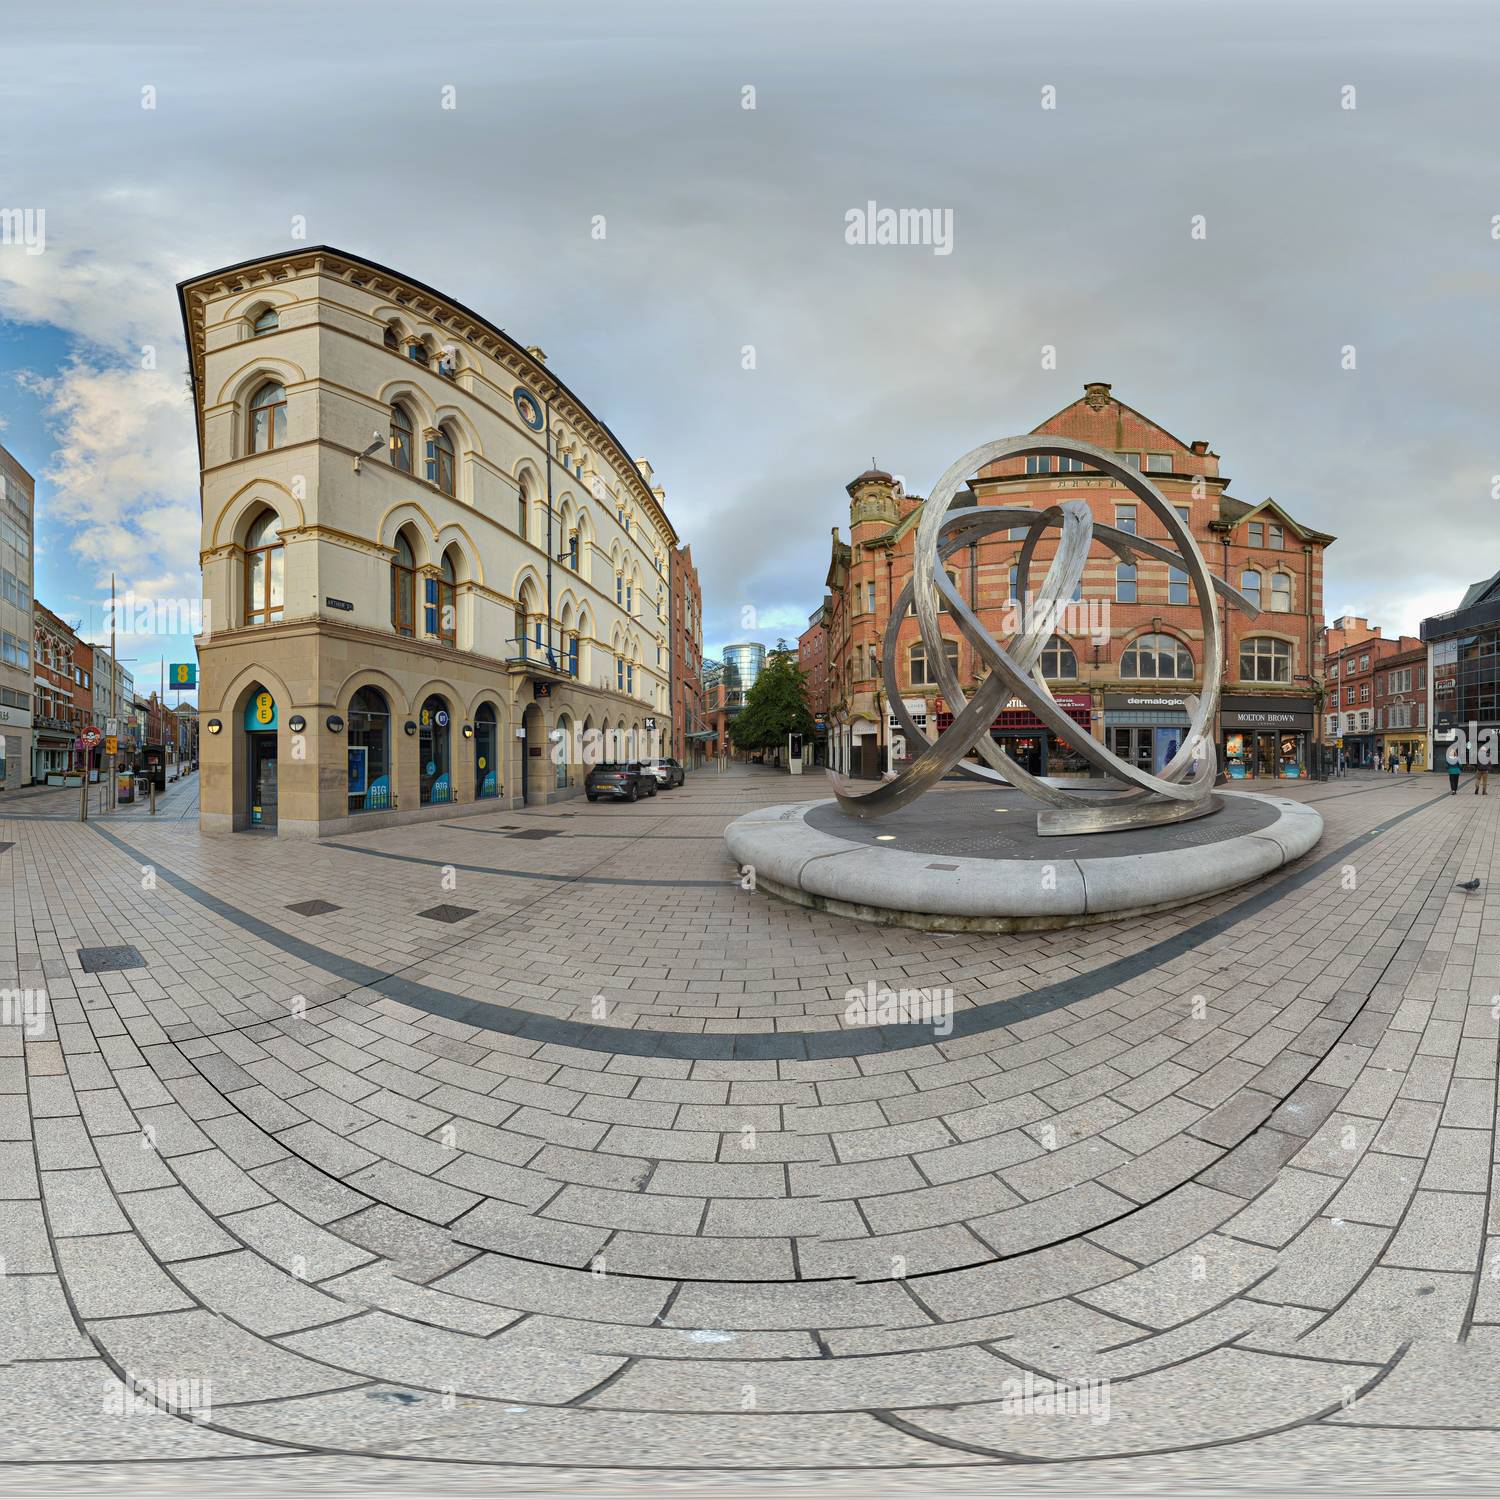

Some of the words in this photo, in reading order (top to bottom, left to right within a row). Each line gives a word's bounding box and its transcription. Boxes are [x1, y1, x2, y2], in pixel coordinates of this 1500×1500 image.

[1237, 713, 1265, 721] MOLTON
[1267, 713, 1294, 722] BROWN
[371, 785, 387, 796] BIG
